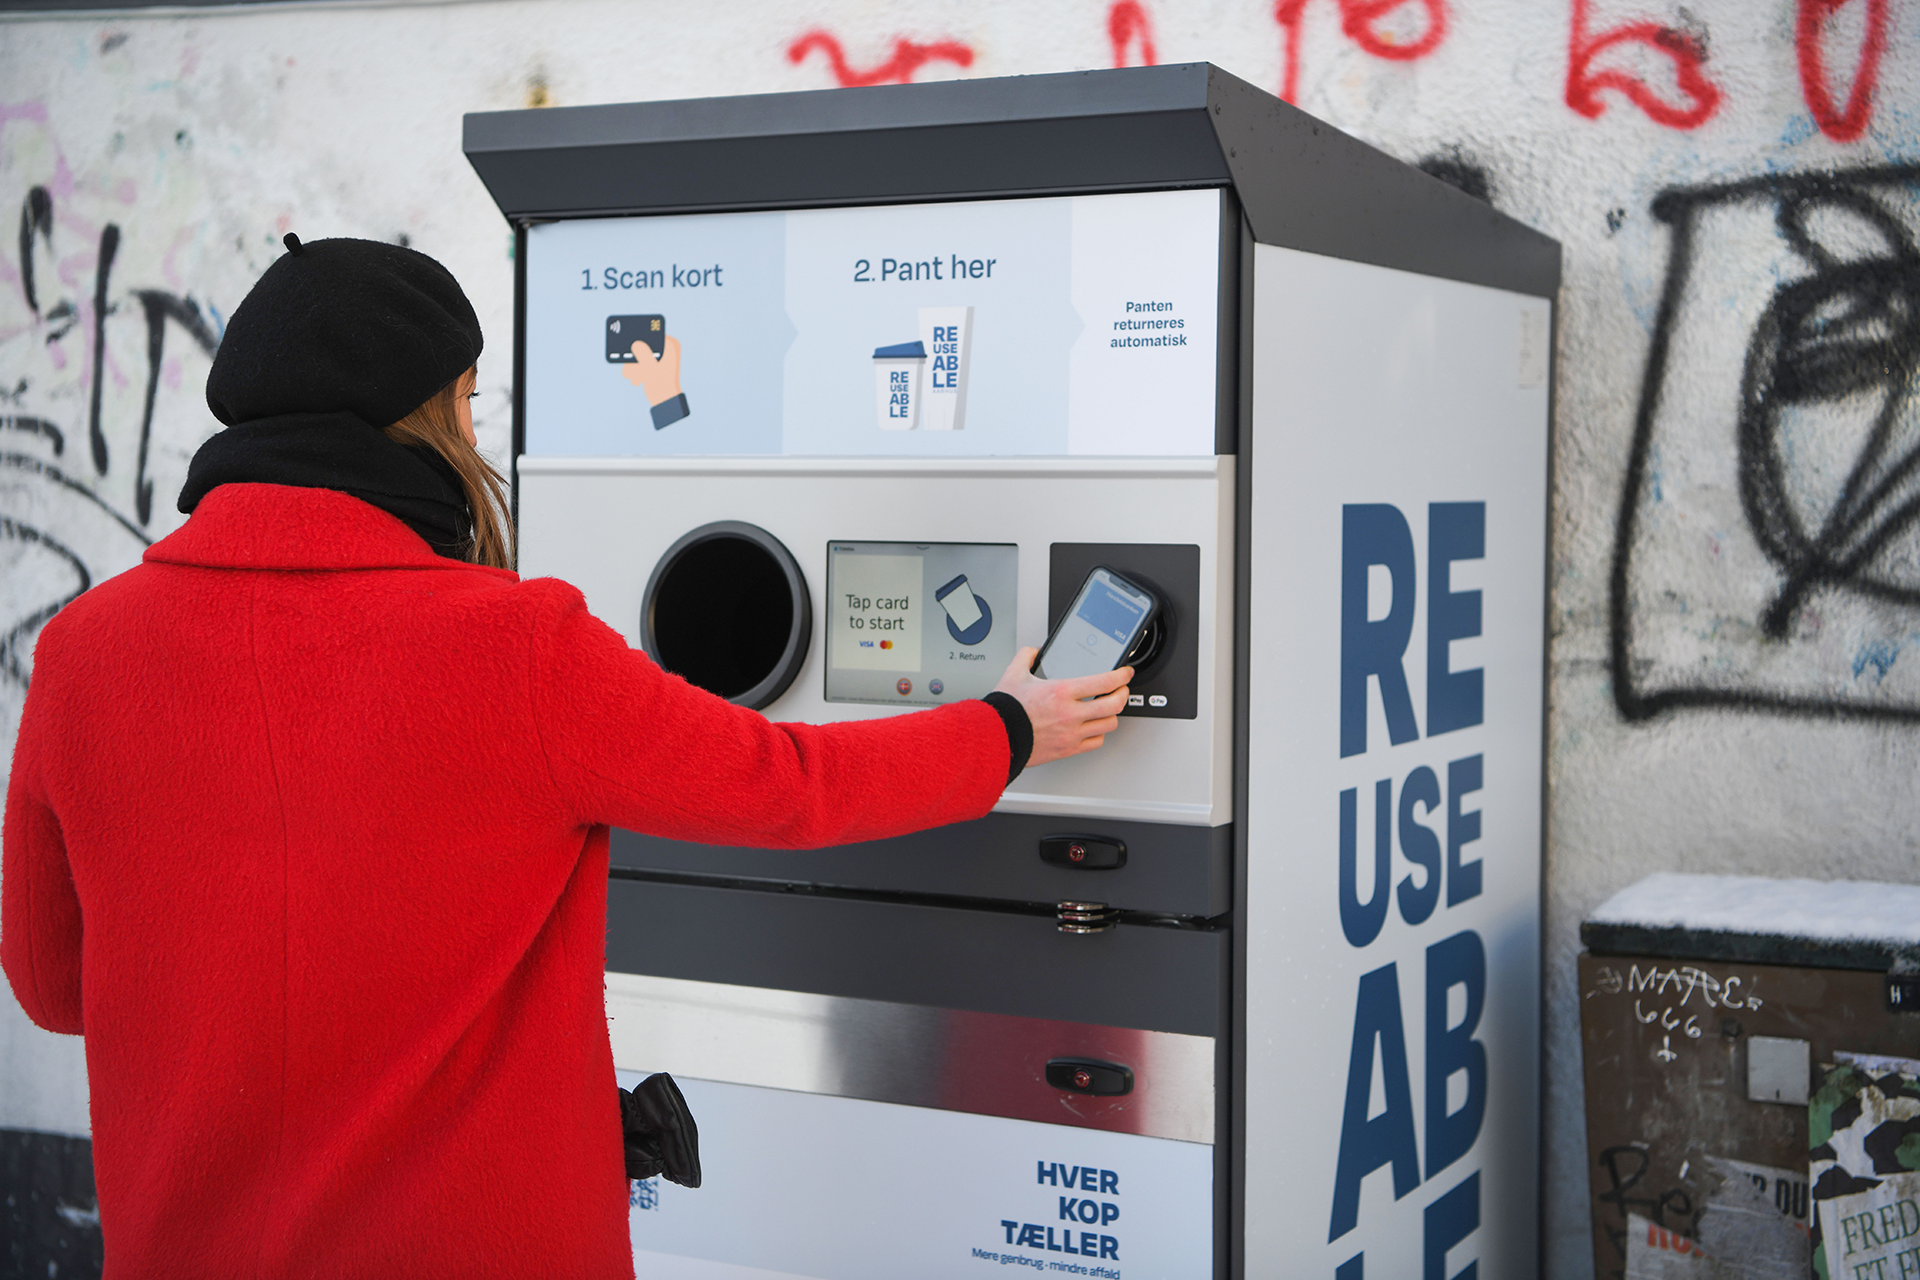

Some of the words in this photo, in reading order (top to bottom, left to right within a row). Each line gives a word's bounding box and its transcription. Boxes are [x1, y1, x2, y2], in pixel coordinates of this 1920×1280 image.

[853, 259, 876, 282] 2.
[881, 256, 943, 281] Pant
[951, 253, 997, 280] her
[581, 269, 598, 290] 1.
[603, 267, 665, 290] Scan
[671, 263, 724, 288] kort
[1126, 300, 1173, 313] Panten
[1113, 317, 1185, 331] returneres
[933, 326, 958, 342] RE
[1110, 333, 1188, 348] automatisk
[933, 343, 957, 354] USE
[932, 355, 959, 371] AB
[890, 371, 909, 383] RE
[932, 372, 957, 388] LE
[890, 384, 909, 392] USE
[889, 393, 909, 405] AB
[889, 406, 908, 418] LE
[846, 594, 871, 611] Tap
[876, 596, 909, 610] card
[850, 616, 865, 629] to
[869, 617, 905, 630] start
[1340, 501, 1486, 759] RE
[1114, 629, 1127, 640] VISA
[859, 640, 875, 648] VISA
[949, 652, 957, 660] 2.
[959, 652, 986, 661] Return
[1339, 752, 1483, 948] USE
[1327, 929, 1488, 1245] AB
[1037, 1160, 1120, 1196] HVER
[1059, 1195, 1120, 1227] KOP
[1840, 1199, 1920, 1256] FRED
[1000, 1219, 1120, 1262] TÆLLER
[971, 1247, 999, 1262] Mere
[1000, 1253, 1044, 1271] genbrug
[1049, 1260, 1088, 1276] mindre
[1089, 1266, 1120, 1280] affald
